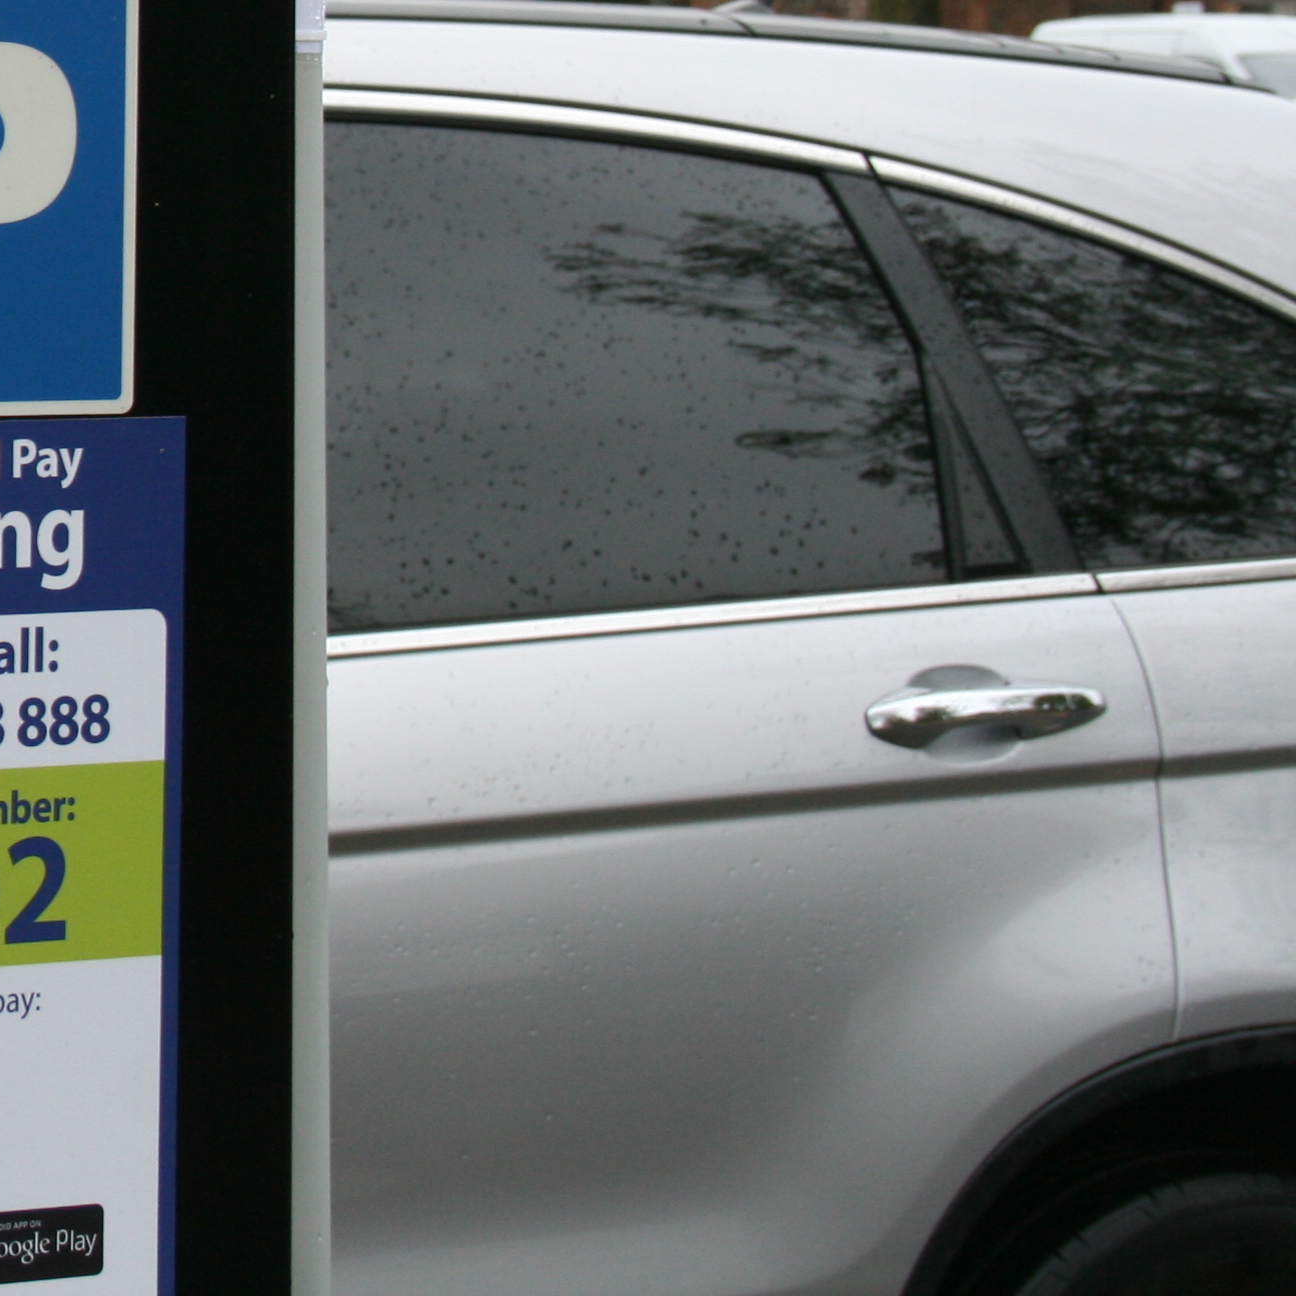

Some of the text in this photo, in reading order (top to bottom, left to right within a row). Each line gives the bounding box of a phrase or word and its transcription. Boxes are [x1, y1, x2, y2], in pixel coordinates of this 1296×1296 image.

[12, 438, 84, 489] Pay
[16, 693, 111, 747] 888
[12, 1219, 29, 1232] APP
[29, 1218, 43, 1230] ON
[55, 1229, 98, 1257] Play
